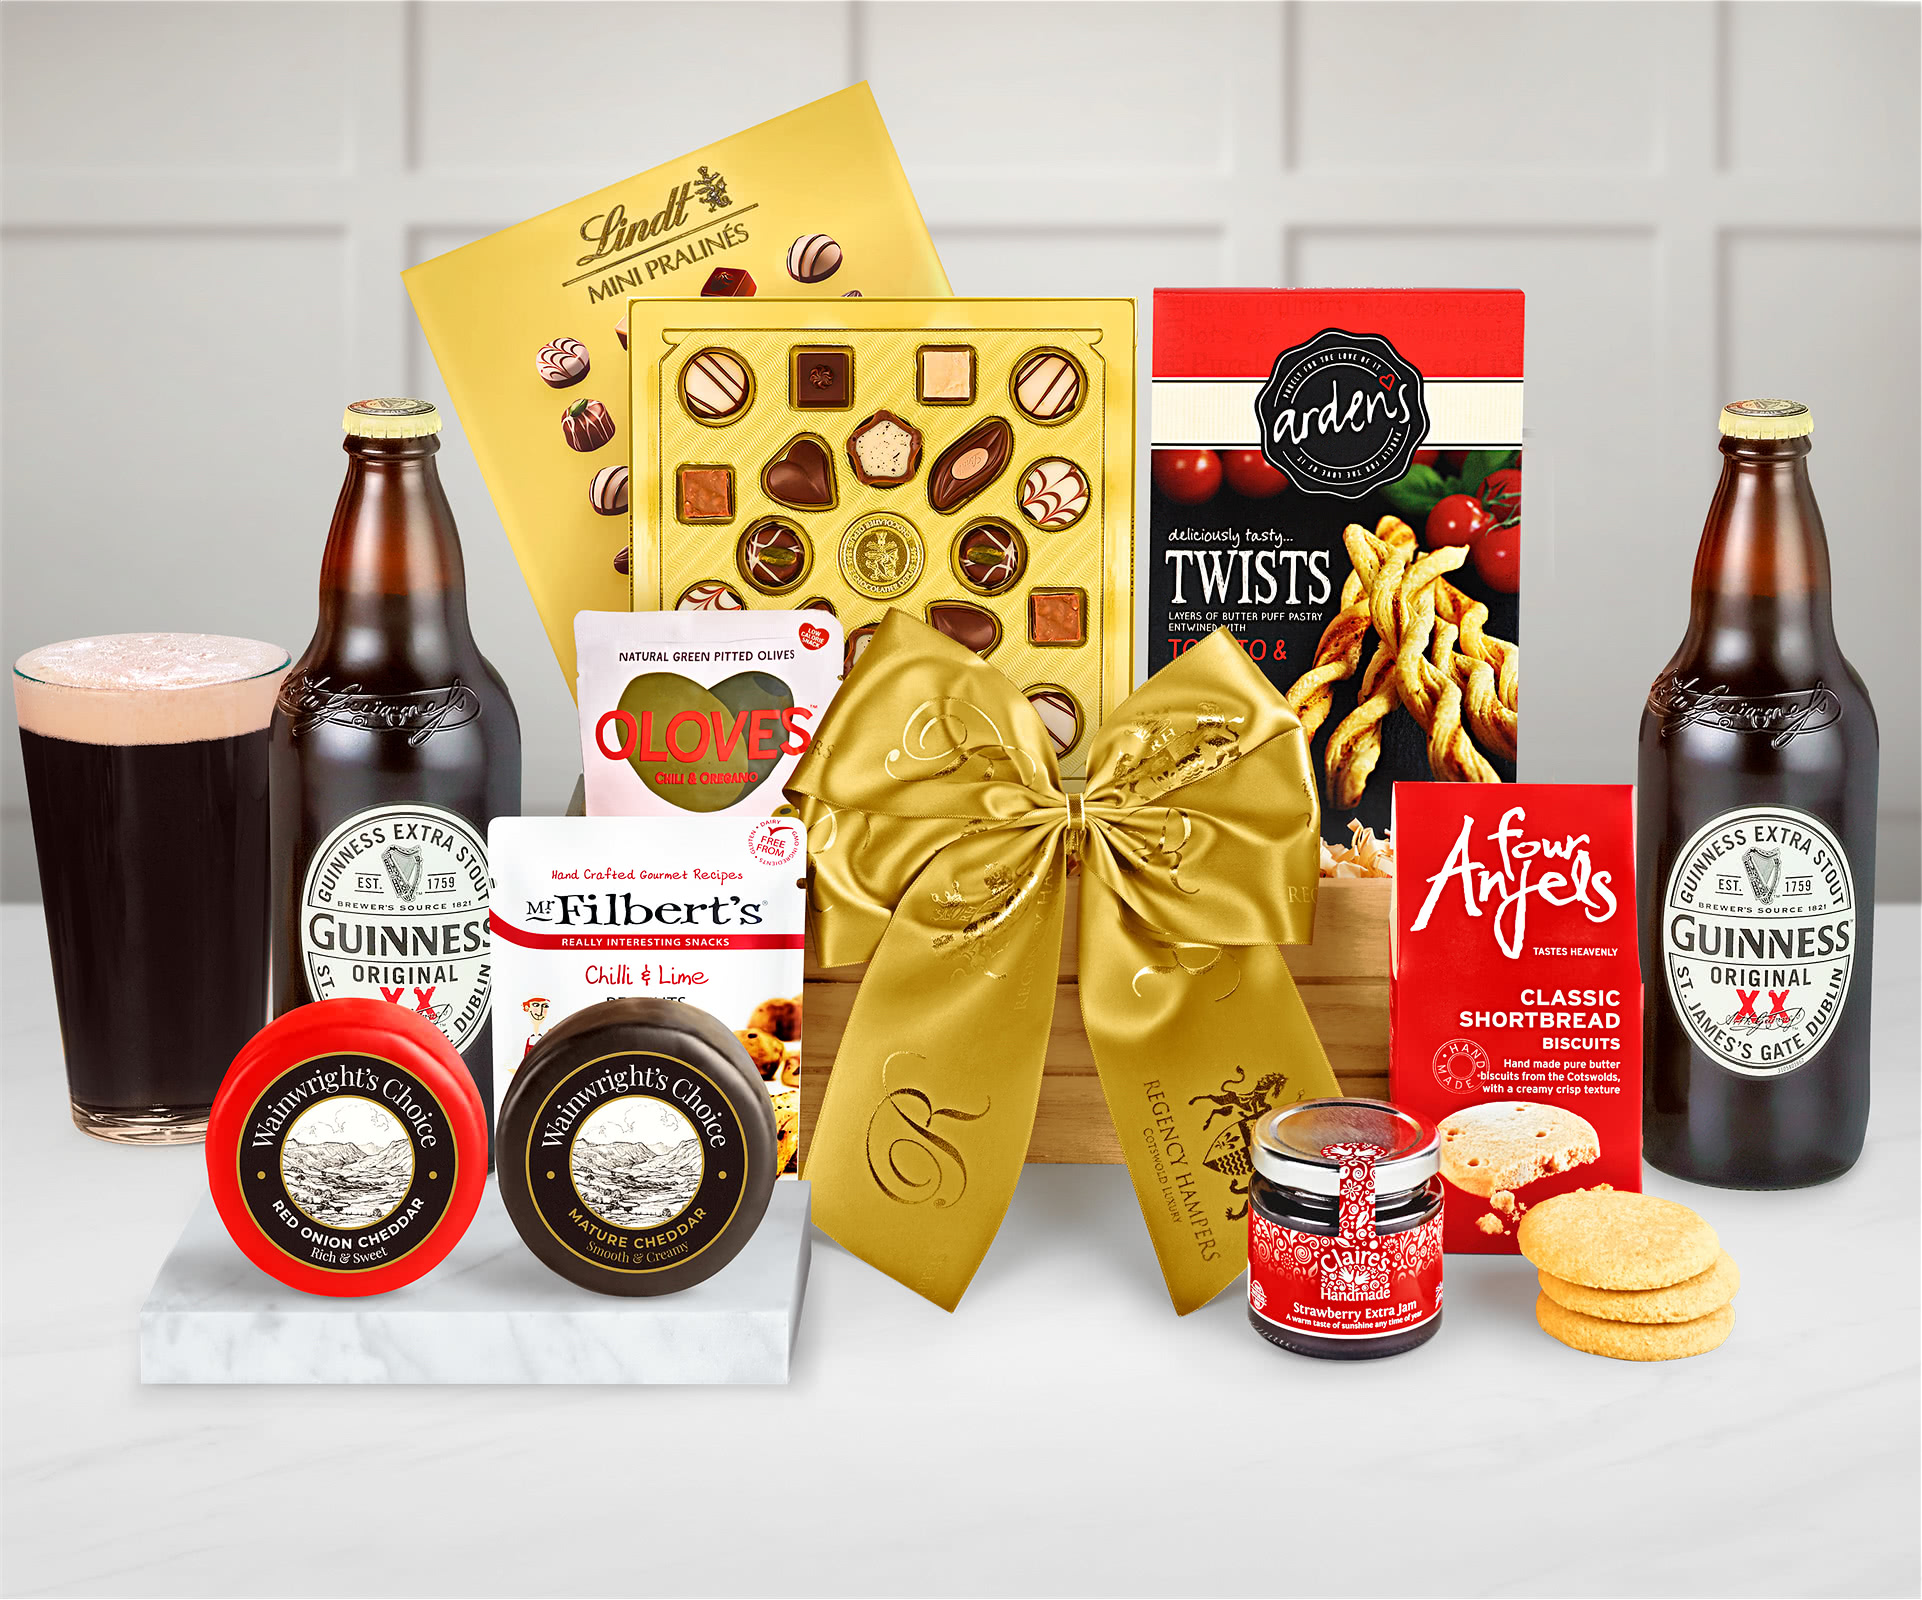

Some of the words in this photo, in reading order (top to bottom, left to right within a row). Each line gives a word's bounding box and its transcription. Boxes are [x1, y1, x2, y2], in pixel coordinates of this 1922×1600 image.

[576, 181, 695, 266] Lindt
[587, 267, 643, 304] MINI
[644, 222, 749, 280] PRALINÉS
[1168, 527, 1240, 548] deliciously
[1245, 528, 1294, 548] tasty...
[1165, 550, 1331, 605] TWISTS
[1168, 611, 1202, 621] LAYERS
[1205, 611, 1219, 621] OF
[1222, 612, 1258, 621] BUTTER
[1261, 612, 1285, 621] PUFF
[1288, 612, 1323, 621] PASTRY
[808, 628, 821, 636] LOW
[1168, 623, 1217, 632] ENTWINED
[618, 651, 669, 662] NATURAL
[673, 651, 710, 662] GREEN
[714, 651, 753, 662] PITTED
[758, 649, 795, 661] OLIVES
[1273, 639, 1287, 660] &
[595, 706, 814, 763] OLOVES
[655, 771, 684, 785] CHILI
[688, 772, 697, 784] &
[760, 819, 781, 827] DAIRY
[748, 830, 756, 855] GLUTEN
[756, 843, 784, 857] FROM
[760, 835, 786, 849] FREE
[1487, 806, 1591, 881] four
[318, 827, 385, 902] GUINNESS
[393, 823, 454, 852] EXTRA
[456, 846, 490, 901] STOUT
[759, 847, 798, 866] INGREDIENTS
[1680, 829, 1747, 904] GUINNESS
[1754, 825, 1812, 855] EXTRA
[1813, 849, 1844, 906] STOUT
[357, 877, 383, 889] EST.
[427, 877, 455, 889] 1759
[551, 869, 579, 880] Hand
[584, 867, 635, 880] Crafted
[640, 870, 688, 880] Gourmet
[693, 868, 743, 886] Recipes
[1718, 878, 1742, 892] EST.
[1785, 880, 1811, 893] 1759
[337, 900, 394, 911] BREWER'S
[399, 903, 447, 911] SOURCE
[452, 900, 472, 908] 1821
[553, 892, 763, 926] Filbert's
[1698, 902, 1753, 914] BREWER'S
[1757, 906, 1803, 914] SOURCE
[1808, 903, 1826, 911] 1821
[561, 938, 602, 947] REALLY
[607, 938, 681, 947] INTERESTING
[685, 938, 730, 947] SNACKS
[1670, 913, 1850, 959] GUINNESS
[1533, 947, 1568, 956] TASTES
[1570, 948, 1618, 956] HEAVENLY
[317, 964, 335, 997] ST.
[352, 964, 458, 984] ORIGINAL
[585, 964, 633, 985] Chilli
[641, 964, 650, 986] &
[659, 964, 709, 985] Lime
[1710, 966, 1811, 988] ORIGINAL
[454, 964, 491, 1033] DUBLIN
[1521, 989, 1620, 1006] CLASSIC
[1459, 1011, 1620, 1029] SHORTBREAD
[1677, 965, 1694, 999] ST.
[1687, 1002, 1751, 1060] JAMES'S
[1760, 1032, 1805, 1061] GATE
[1809, 967, 1844, 1038] DUBLIN
[1542, 1037, 1620, 1050] BISCUITS
[1449, 1043, 1485, 1069] HAND
[1503, 1059, 1530, 1068] Hand
[1533, 1059, 1560, 1068] made
[1564, 1061, 1586, 1070] pure
[1589, 1060, 1621, 1069] butter
[1437, 1064, 1474, 1090] MADE
[1480, 1071, 1519, 1080] biscuits
[1522, 1071, 1545, 1081] from
[1548, 1072, 1565, 1081] the
[1567, 1072, 1621, 1082] Cotswolds,
[1482, 1083, 1504, 1093] with
[1516, 1085, 1553, 1095] creamy
[1556, 1084, 1581, 1095] crisp
[1584, 1084, 1621, 1094] texture
[252, 1064, 380, 1150] Wainwright's
[382, 1078, 437, 1149] Choice
[541, 1064, 669, 1148] Wainwright's
[672, 1078, 727, 1149] Choice
[1143, 1079, 1188, 1167] REGENCY
[1175, 1172, 1221, 1262] HAMPERS
[1143, 1127, 1169, 1184] COTSWOLD
[1162, 1186, 1183, 1224] LUXURY
[272, 1199, 299, 1229] RED
[300, 1226, 352, 1249] ONION
[358, 1197, 425, 1248] CHEDDAR
[567, 1207, 627, 1248] MATURE
[634, 1207, 708, 1249] CHEDDAR
[310, 1247, 336, 1263] Rich
[339, 1252, 351, 1263] &
[353, 1245, 388, 1264] Sweet
[585, 1240, 629, 1264] Smooth
[632, 1252, 644, 1264] &
[646, 1240, 690, 1264] Creamy
[1320, 1246, 1390, 1272] Claire's
[1320, 1286, 1391, 1301] Handmade
[1292, 1316, 1312, 1325] warm
[1313, 1319, 1331, 1329] taste
[1374, 1320, 1388, 1329] any
[1388, 1317, 1403, 1326] time
[1404, 1313, 1411, 1322] of
[1410, 1310, 1423, 1322] year
[1293, 1302, 1361, 1322] Strawberry
[1365, 1306, 1395, 1319] Extra
[1397, 1300, 1417, 1316] Jam
